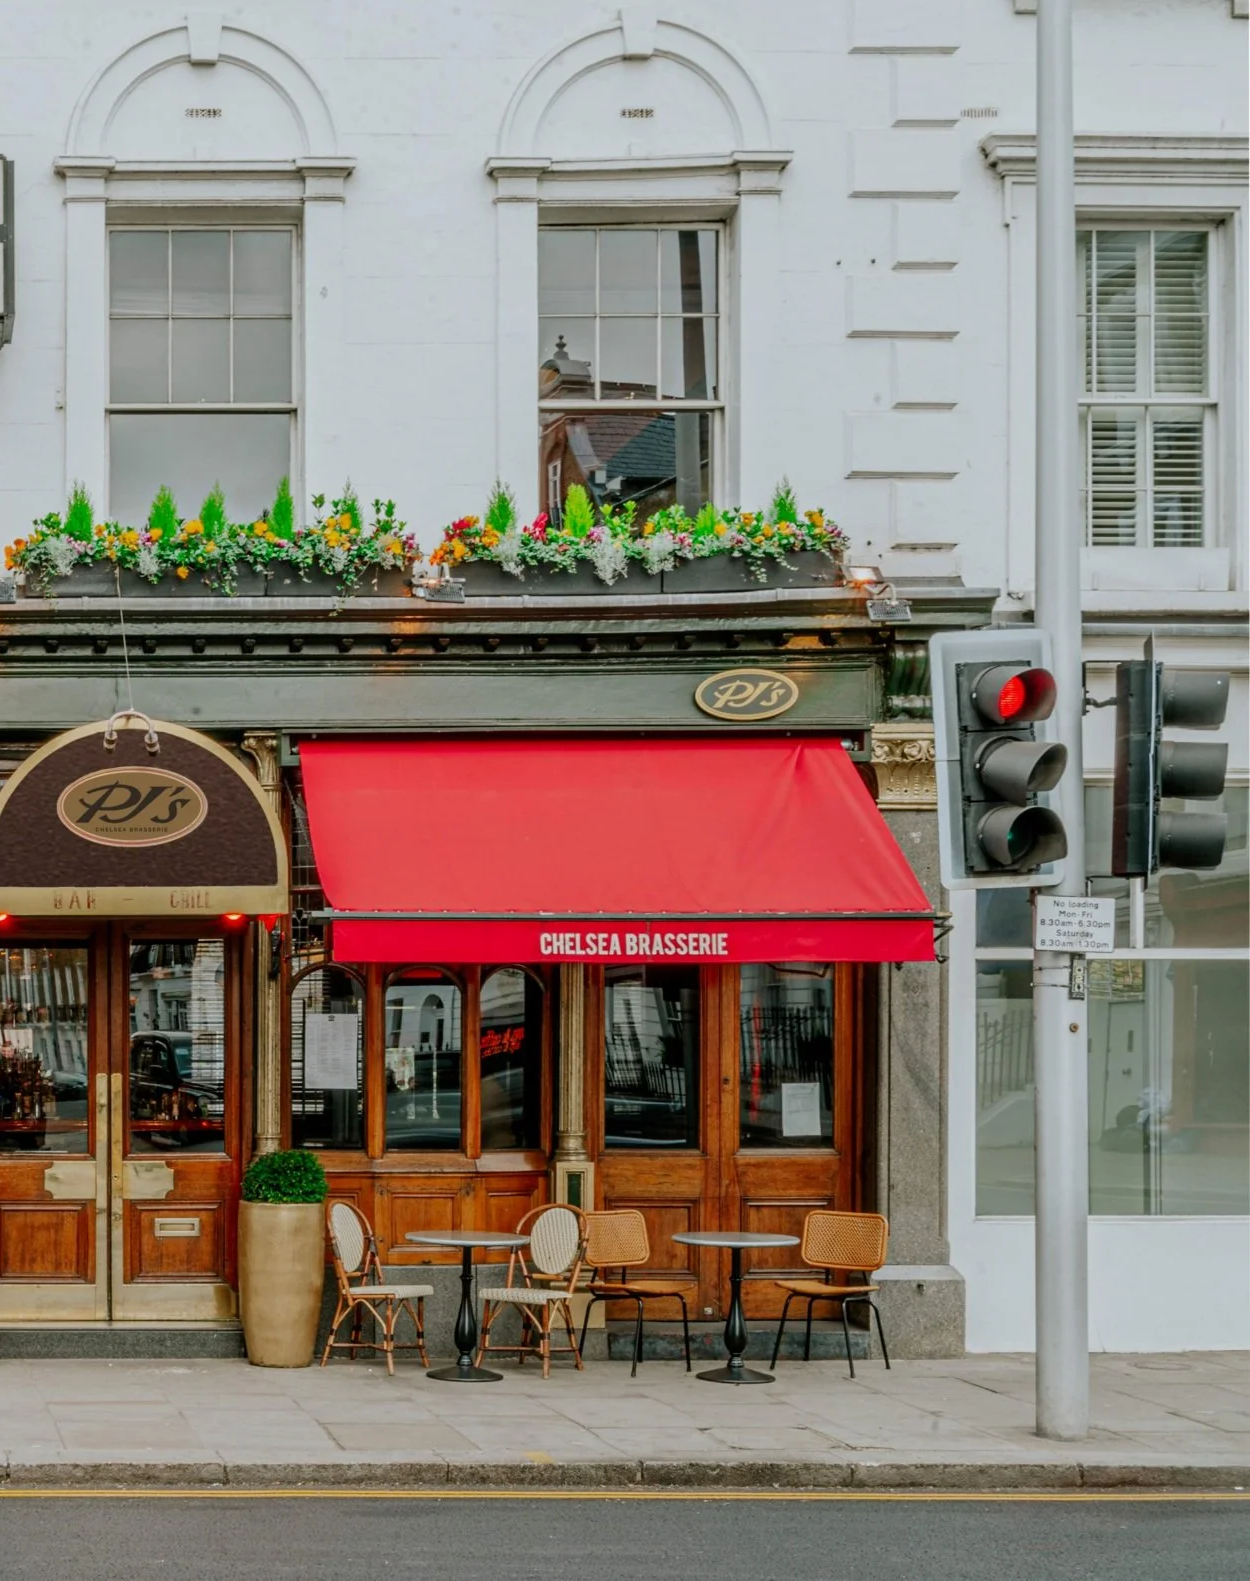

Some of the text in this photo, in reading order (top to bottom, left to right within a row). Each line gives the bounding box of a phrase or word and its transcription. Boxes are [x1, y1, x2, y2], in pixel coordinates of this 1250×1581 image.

[713, 680, 786, 708] PJ's
[76, 780, 191, 824] PJ's
[1053, 900, 1099, 909] No loading
[540, 933, 729, 956] CHELSEA BRASSERIE
[1056, 929, 1094, 938] Saturday
